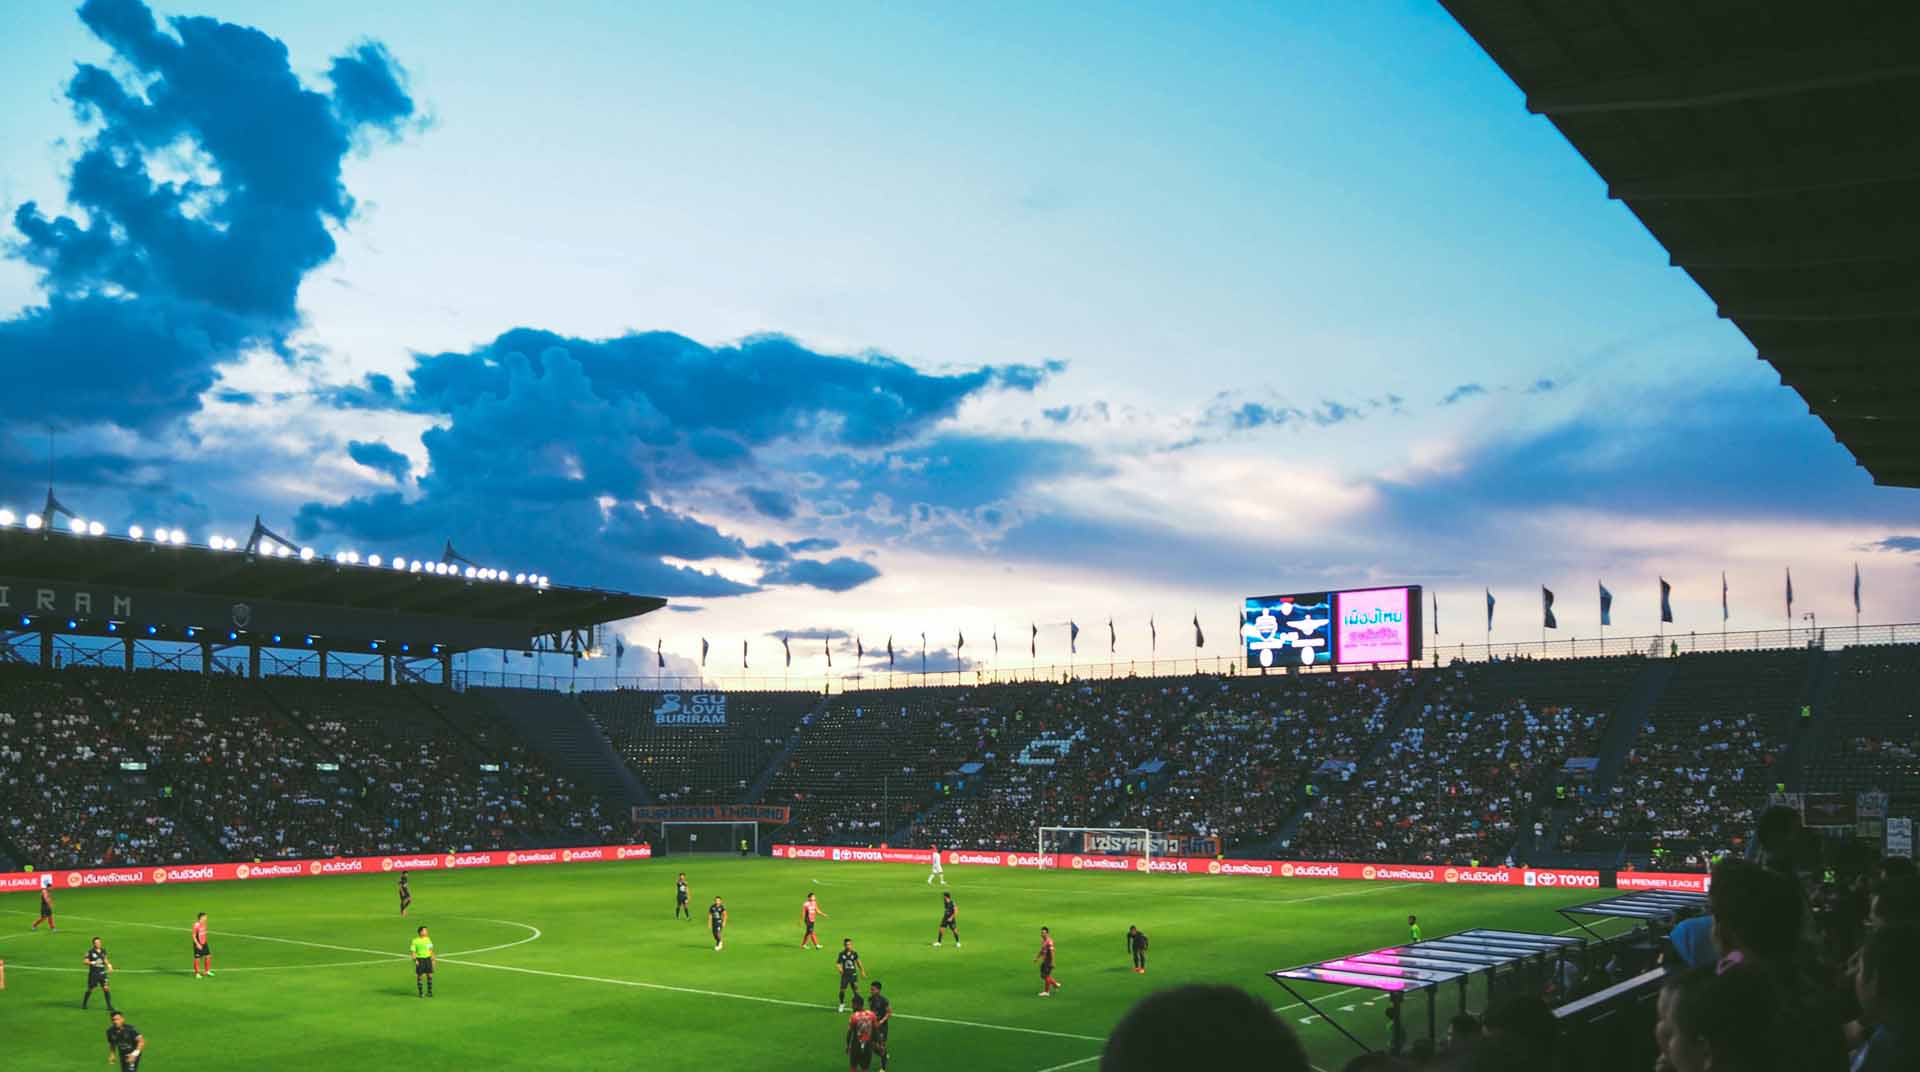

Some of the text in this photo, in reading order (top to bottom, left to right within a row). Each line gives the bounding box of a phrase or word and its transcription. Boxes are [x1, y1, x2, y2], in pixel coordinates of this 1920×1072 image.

[692, 694, 725, 704] GU
[683, 704, 725, 714] LOVE
[656, 714, 725, 723] BURIRAM
[852, 851, 882, 861] TOYOTA
[1632, 878, 1667, 888] PREMIER
[1669, 879, 1700, 888] LEAGUE
